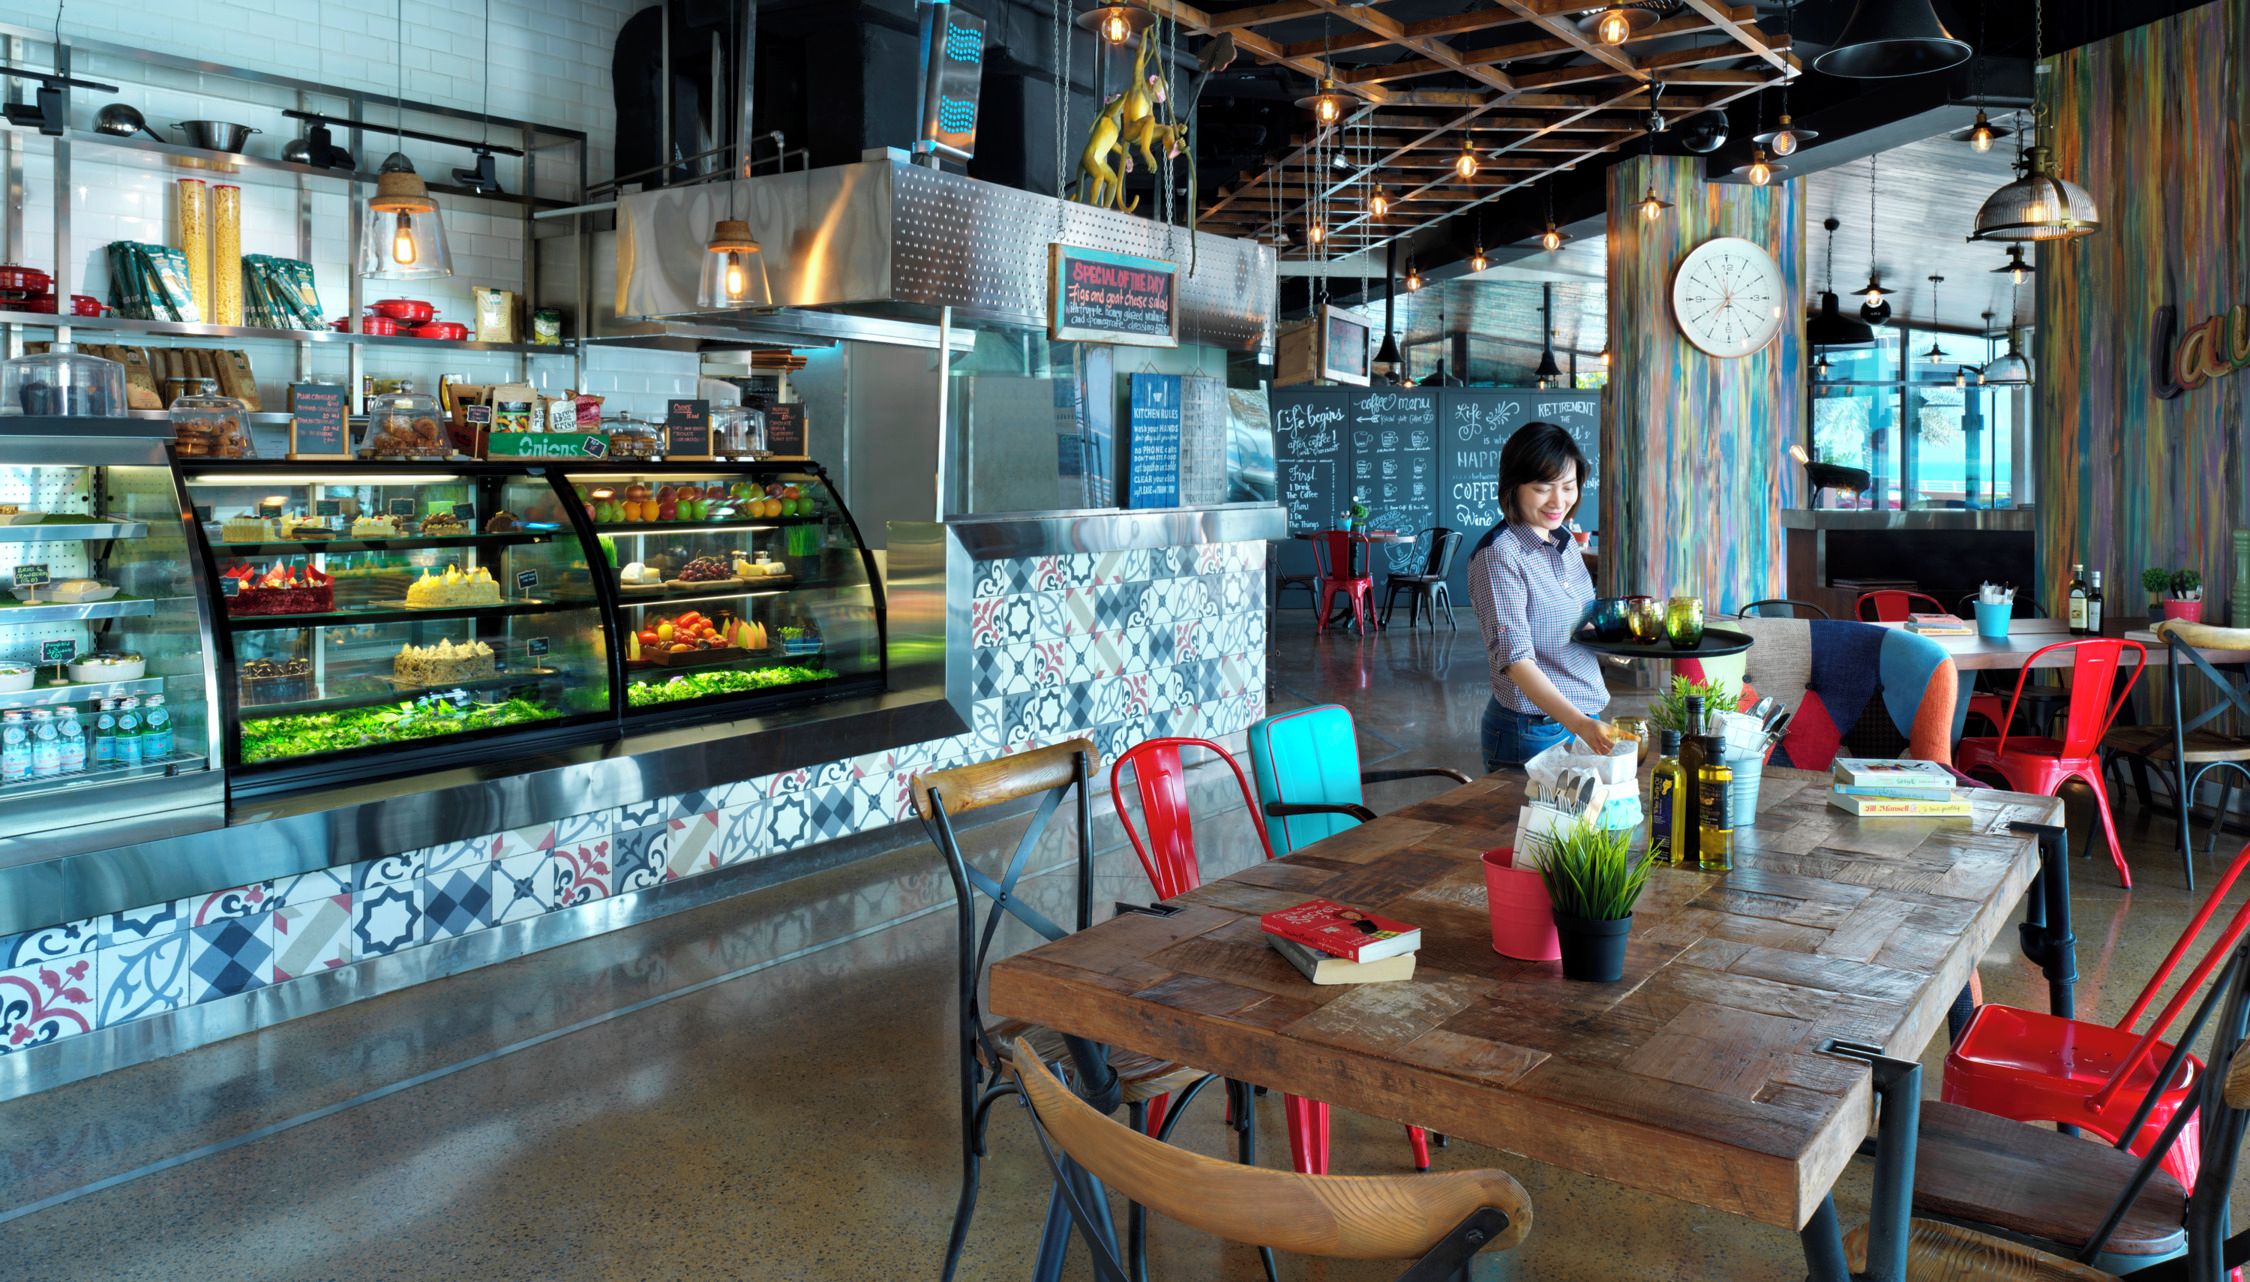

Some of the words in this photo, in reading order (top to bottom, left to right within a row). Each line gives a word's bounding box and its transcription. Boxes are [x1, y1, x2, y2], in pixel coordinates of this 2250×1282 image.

[1072, 261, 1117, 287] SPECIAL
[1117, 269, 1129, 289] OF
[1129, 271, 1146, 292] THE
[1147, 273, 1165, 294] DAY
[1068, 282, 1090, 307] Figs
[1090, 288, 1105, 305] and
[1106, 288, 1123, 309] goat
[1124, 289, 1147, 309] cheese
[1148, 293, 1169, 312] salad
[1360, 393, 1397, 415] coffee
[1398, 397, 1431, 411] menu
[1537, 401, 1596, 417] RETIREMENT
[1133, 408, 1160, 419] KITCHEN
[1161, 409, 1178, 419] RULES
[1560, 415, 1571, 423] THE
[1159, 424, 1178, 433] HANDS
[1276, 404, 1306, 440] Life
[1307, 404, 1345, 432] begins
[1455, 403, 1482, 441] Life
[519, 436, 578, 457] Onions
[1483, 435, 1490, 445] is
[1142, 446, 1164, 454] PHONE
[1134, 475, 1153, 483] CLEAR
[1294, 482, 1311, 491] Drink
[1286, 491, 1298, 499] The
[1300, 490, 1319, 499] Coffee
[1453, 481, 1499, 501] COFFE
[1456, 504, 1495, 527] Wine
